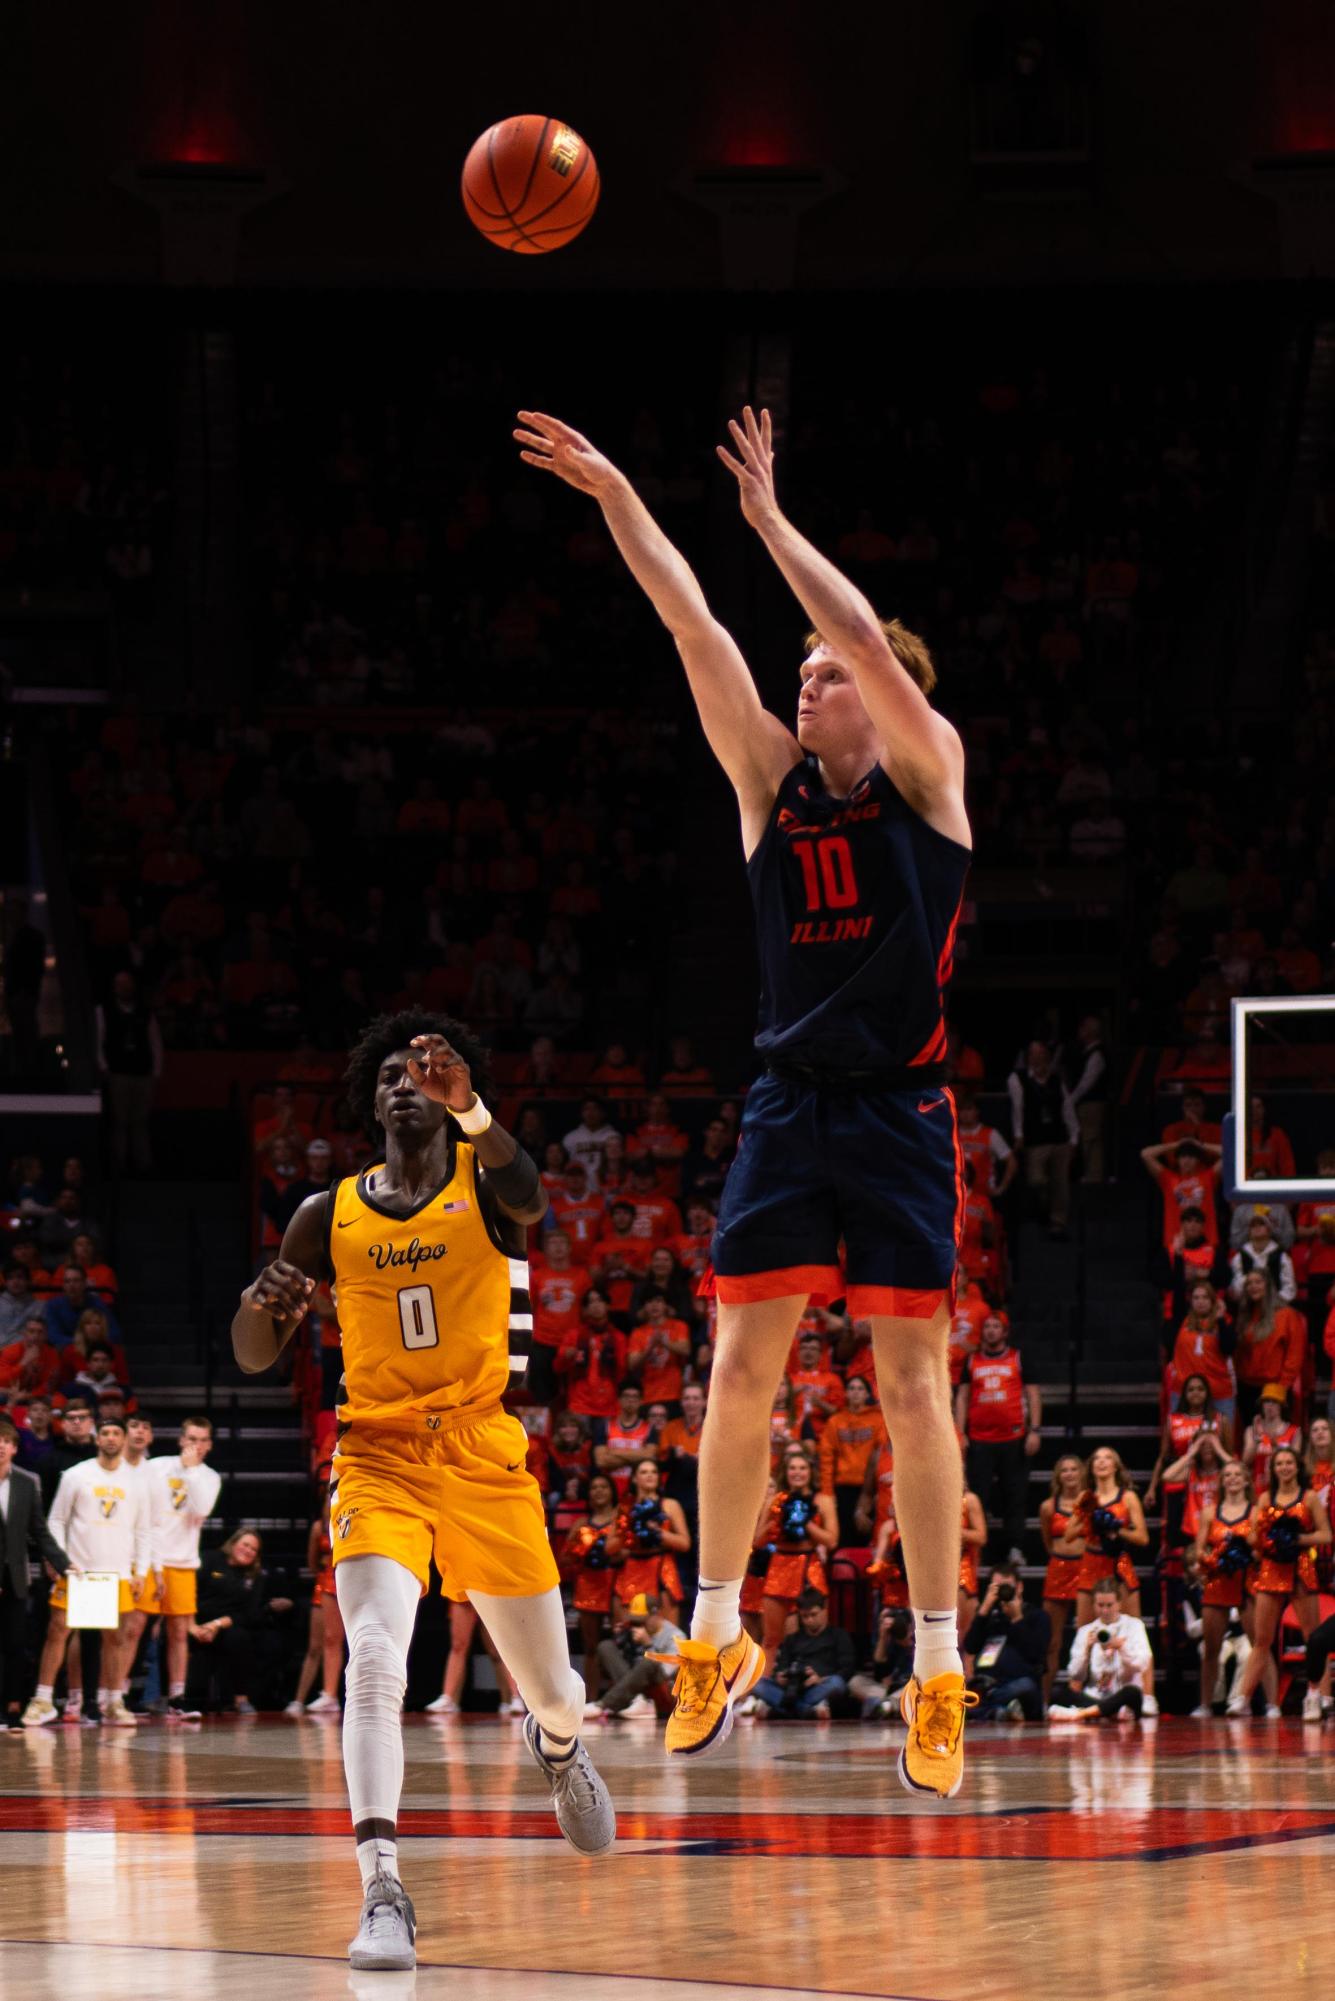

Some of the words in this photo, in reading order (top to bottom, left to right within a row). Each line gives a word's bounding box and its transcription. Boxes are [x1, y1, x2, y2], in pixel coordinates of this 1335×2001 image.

[792, 836, 858, 911] 10
[790, 916, 873, 943] ILLINI
[367, 1237, 448, 1272] Valpo
[397, 1283, 440, 1350] 0
